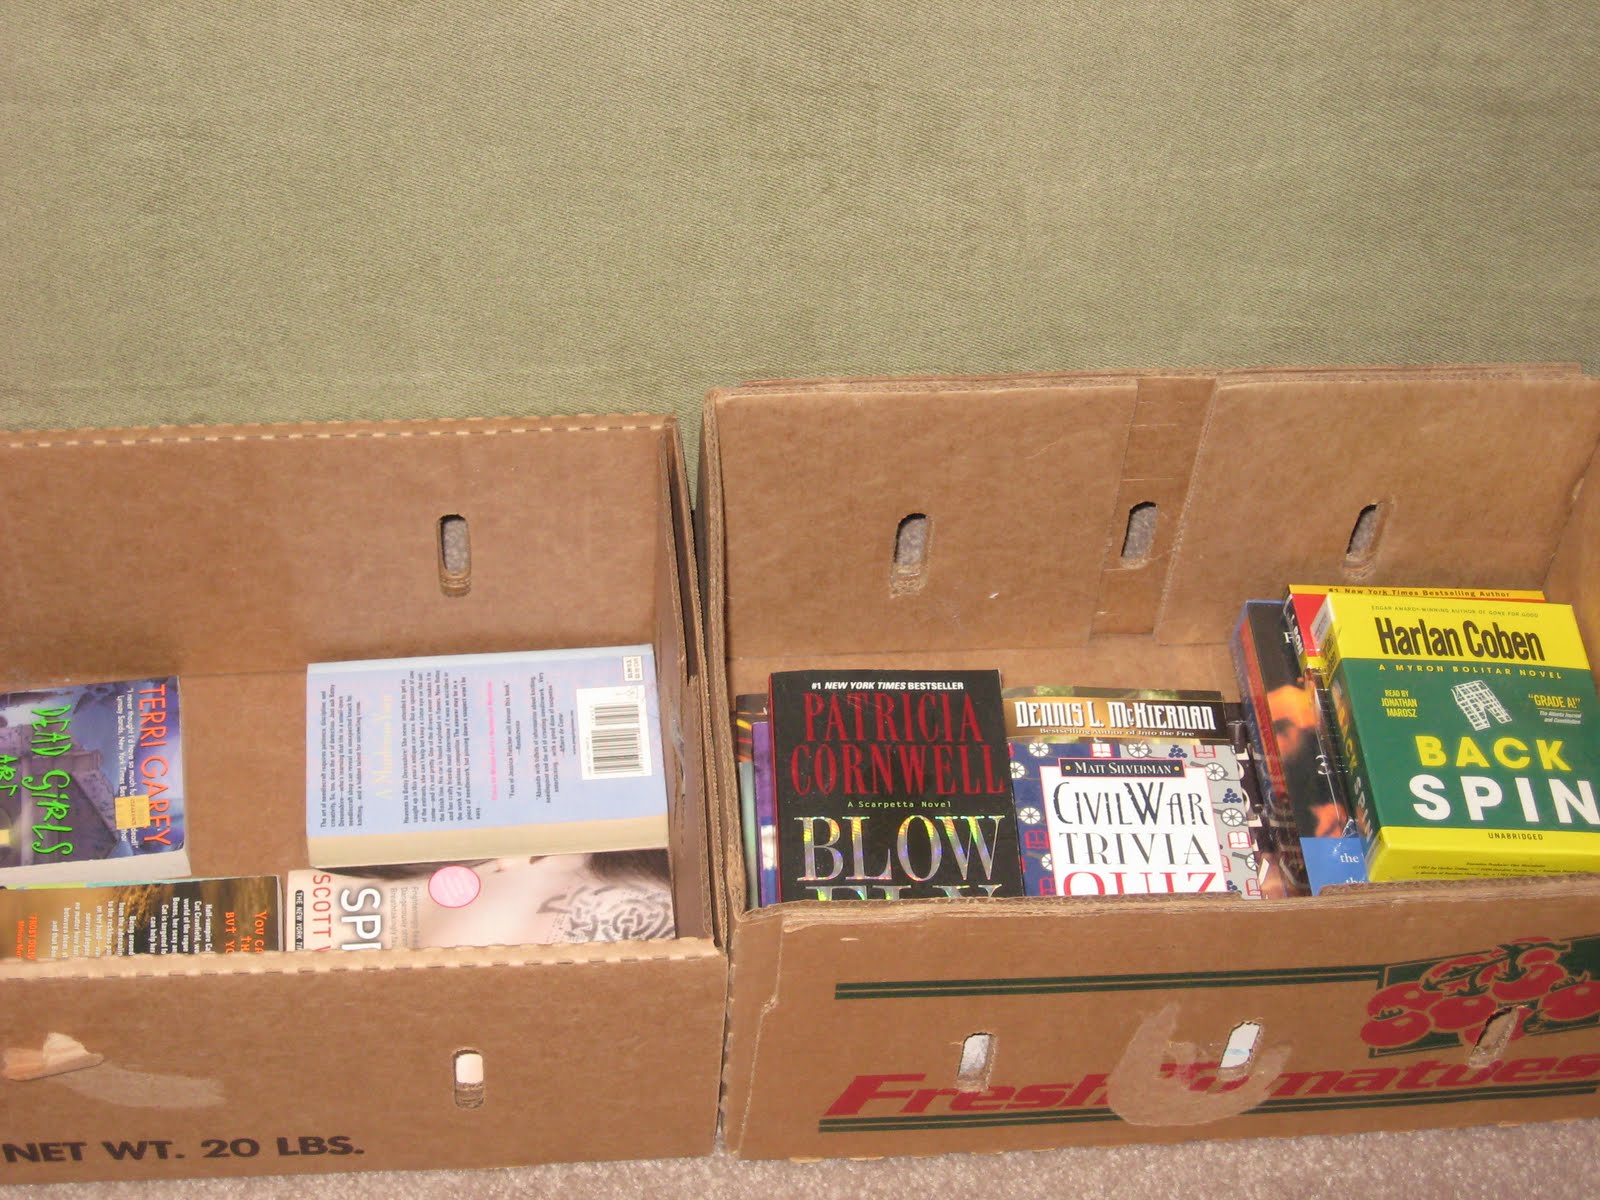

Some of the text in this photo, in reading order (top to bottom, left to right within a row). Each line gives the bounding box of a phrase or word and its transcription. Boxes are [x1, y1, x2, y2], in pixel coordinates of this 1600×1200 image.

[1422, 590, 1476, 598] Bestselling
[1375, 617, 1464, 658] Harlan
[1463, 620, 1546, 662] Coben
[1452, 666, 1511, 676] BOLITAR
[1520, 670, 1562, 679] NOVEL
[812, 682, 964, 690] #1 NEW YORK TIMES BESTSELLER
[116, 695, 124, 714] Lynsay
[1381, 697, 1418, 707] JONATHAN
[1386, 708, 1418, 718] MAROSZ
[126, 710, 134, 734] thought
[802, 692, 983, 742] PATRICIA
[1014, 701, 1086, 728] DENNIS
[31, 705, 72, 758] DEAD
[1040, 728, 1091, 736] Bestselling
[1092, 728, 1122, 736] Author
[119, 752, 127, 765] York
[139, 684, 172, 846] TERRI GAREY
[1415, 736, 1572, 771] BACK
[791, 744, 1006, 795] CORNWELL
[1075, 762, 1171, 776] MATT SILVERMAN
[859, 801, 914, 809] Scarpetta
[922, 800, 952, 808] Novel
[1054, 782, 1209, 825] CIVIL WAR
[1409, 774, 1600, 826] SPIN
[794, 815, 1006, 882] BLOW
[1488, 832, 1544, 841] UNABRIDGED
[1059, 832, 1210, 866] TRIVIA
[1340, 852, 1360, 863] the
[161, 905, 169, 915] Cat
[194, 901, 202, 911] Cat
[313, 874, 331, 938] SCOTT
[160, 922, 168, 948] targeted
[2, 1136, 365, 1164] NET WT. 20 LBS.
